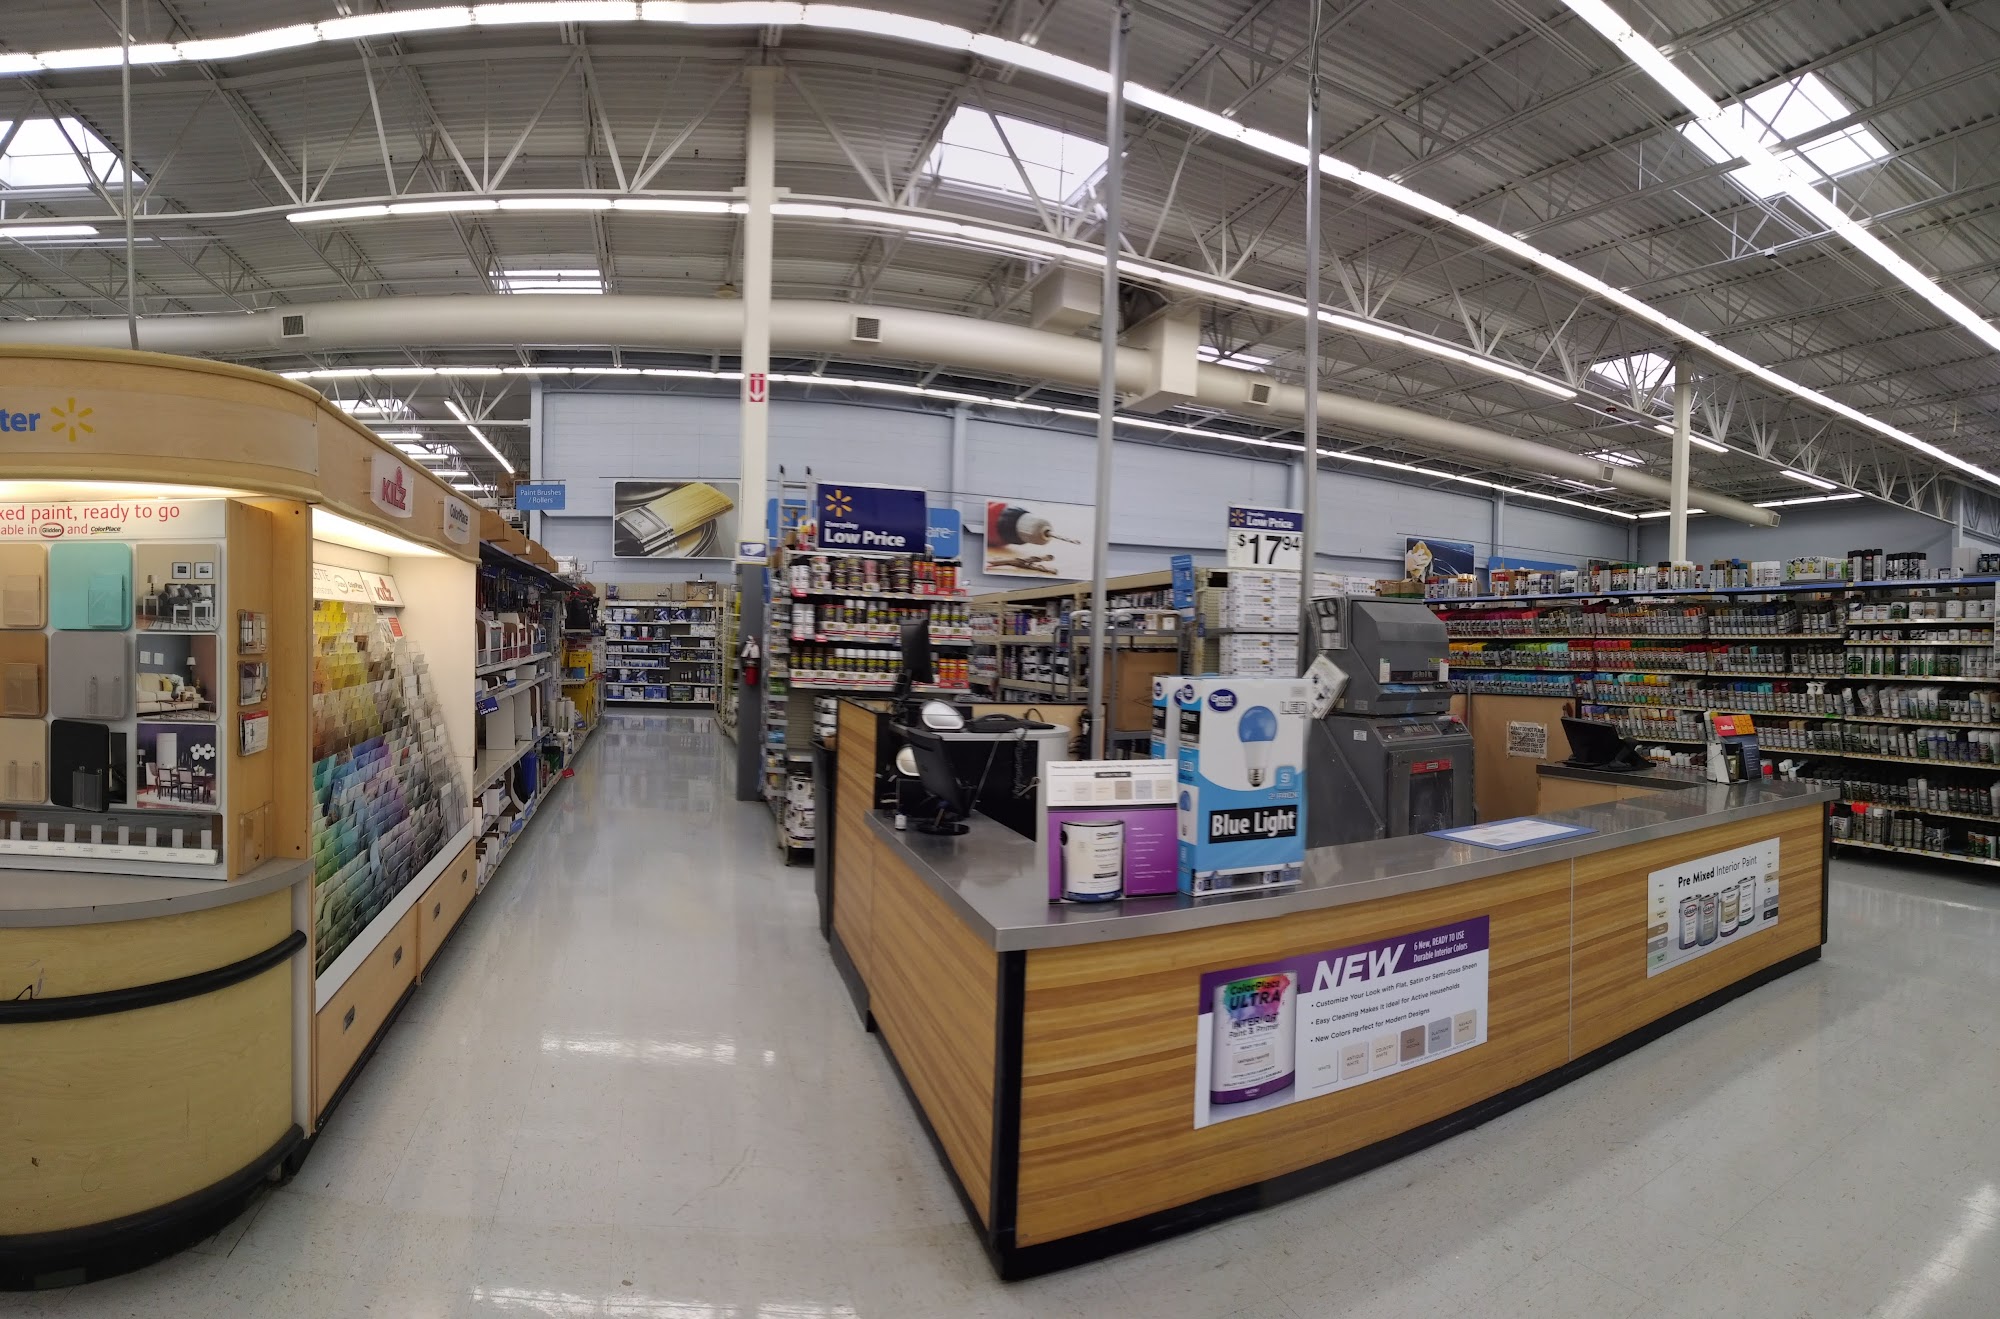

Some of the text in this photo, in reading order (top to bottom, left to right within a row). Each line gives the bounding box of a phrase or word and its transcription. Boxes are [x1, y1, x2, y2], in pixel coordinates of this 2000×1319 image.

[382, 477, 406, 510] KILZ
[32, 505, 78, 524] paint,
[84, 504, 129, 522] ready
[135, 504, 152, 519] to
[158, 506, 180, 522] go
[449, 504, 468, 525] ColorPlace
[0, 524, 24, 535] able
[28, 524, 37, 535] in
[67, 524, 88, 535] and
[824, 528, 906, 547] Low Price
[1212, 809, 1296, 837] Blue Light
[1678, 876, 1691, 888] Pre
[1693, 867, 1715, 884] Mixed
[1716, 861, 1740, 876] Interior
[1742, 856, 1757, 868] Paint
[1413, 930, 1465, 951] 6 New, READY TO USE
[1413, 942, 1468, 963] Durable Interior Colors
[1311, 944, 1406, 992] NEW
[1315, 996, 1348, 1008] Customize
[1350, 992, 1364, 1000] Your
[1365, 988, 1380, 997] Look
[1382, 984, 1394, 993] with
[1409, 977, 1423, 985] Satin
[1432, 967, 1461, 980] Semi-Gloss
[1462, 962, 1477, 972] Sheen
[1230, 991, 1281, 1010] ULTRA
[1315, 1017, 1330, 1026] Easy
[1331, 1010, 1359, 1022] Cleaning
[1360, 1005, 1379, 1014] Makes
[1411, 993, 1428, 1002] Active
[1429, 983, 1460, 997] Households
[1330, 1029, 1351, 1039] Colors
[1352, 1023, 1374, 1033] Perfect
[1375, 1020, 1384, 1028] for
[1385, 1014, 1407, 1025] Modern
[1408, 1007, 1430, 1019] Designs
[1346, 1052, 1365, 1061] ANTIQUE
